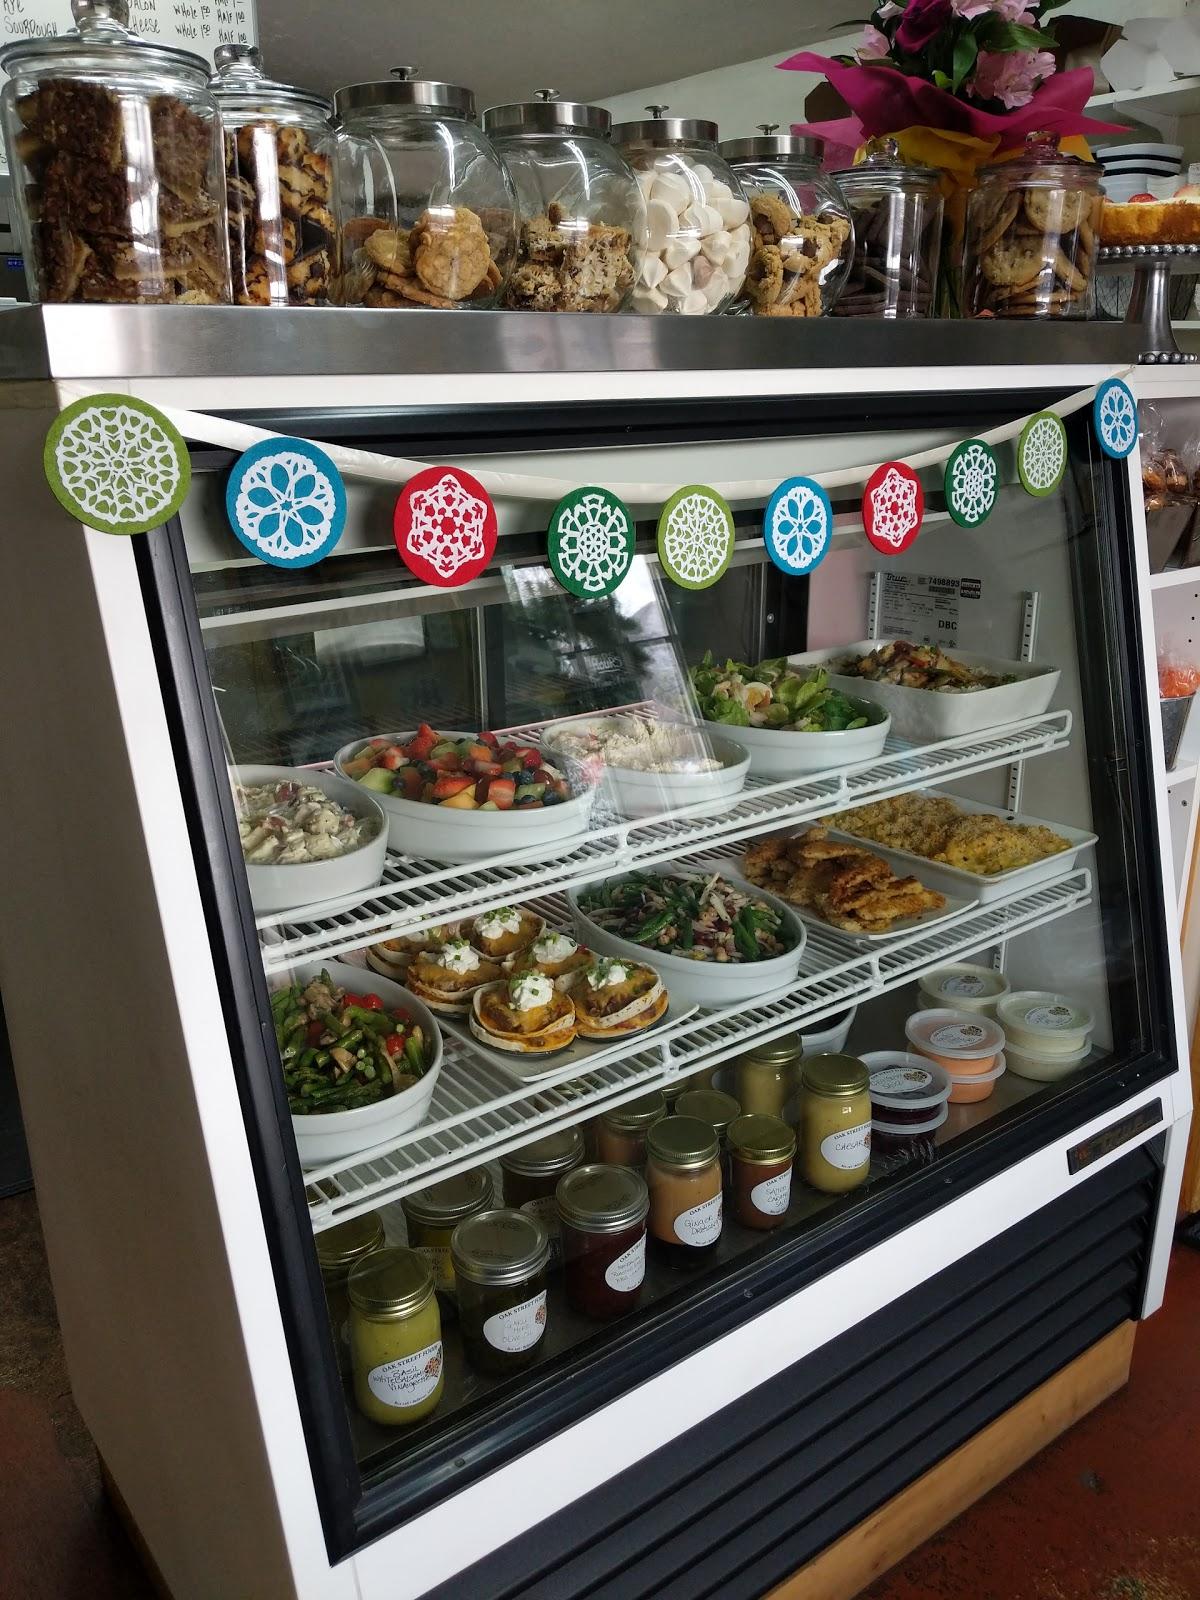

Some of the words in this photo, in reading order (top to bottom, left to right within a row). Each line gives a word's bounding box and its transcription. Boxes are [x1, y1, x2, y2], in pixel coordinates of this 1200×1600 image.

[4, 15, 58, 38] SOURDOUGH
[938, 620, 957, 630] DBC
[498, 1311, 513, 1320] OAK
[513, 1300, 535, 1313] STREET
[382, 1364, 398, 1373] OAK
[397, 1352, 423, 1367] STREET
